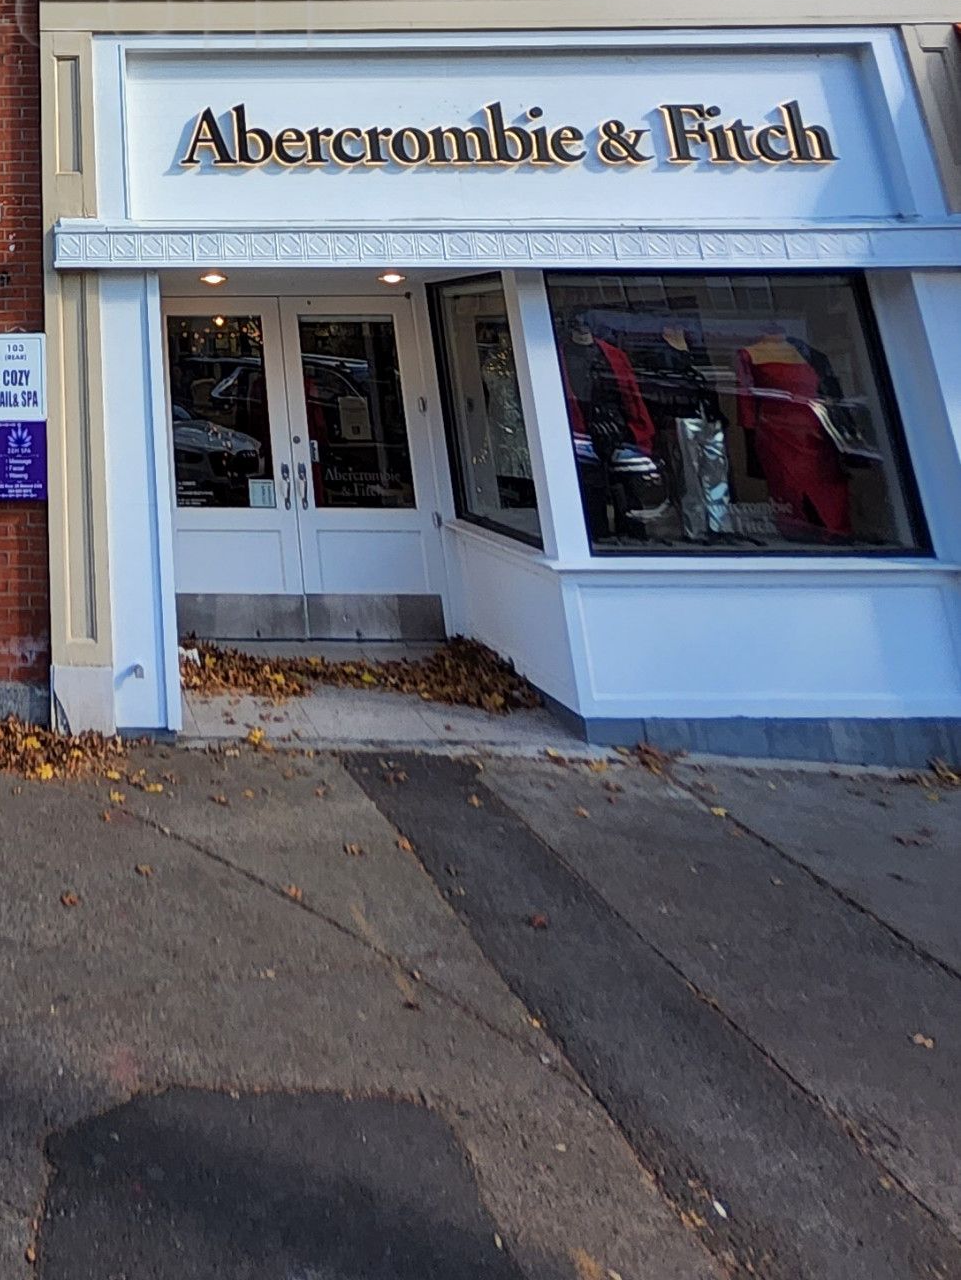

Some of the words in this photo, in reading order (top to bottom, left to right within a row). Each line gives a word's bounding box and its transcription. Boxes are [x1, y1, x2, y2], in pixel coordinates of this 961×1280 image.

[180, 101, 587, 166] Abercrombie
[597, 119, 655, 165] &
[659, 100, 840, 165] Fitch
[7, 344, 25, 352] 103
[2, 369, 31, 387] COZY
[20, 390, 39, 408] SPA
